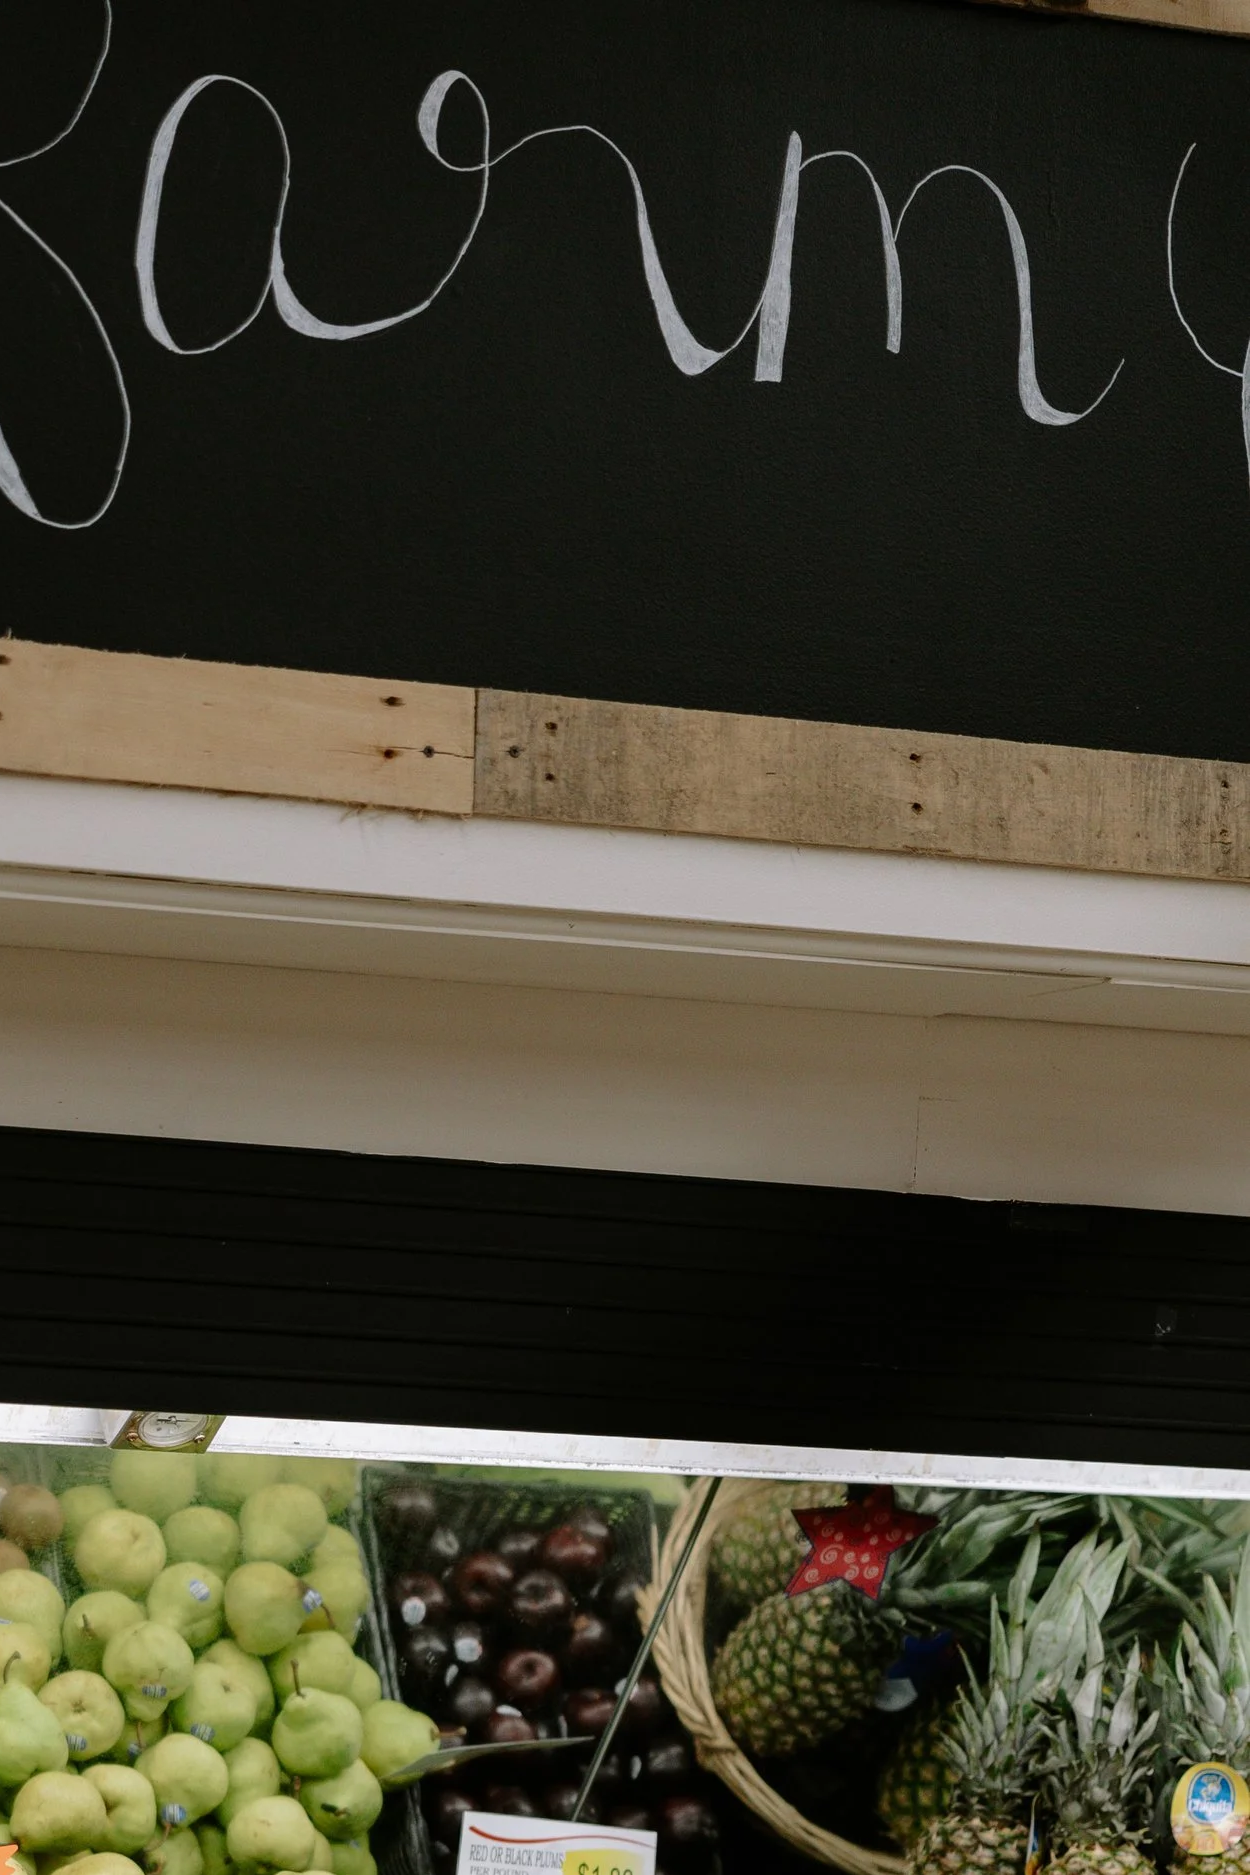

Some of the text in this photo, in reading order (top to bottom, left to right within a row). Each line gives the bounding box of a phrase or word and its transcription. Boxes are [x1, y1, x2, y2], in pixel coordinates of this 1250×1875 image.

[469, 1844, 565, 1870] RED OR BLACK PLUMS
[469, 1865, 490, 1875] PER
